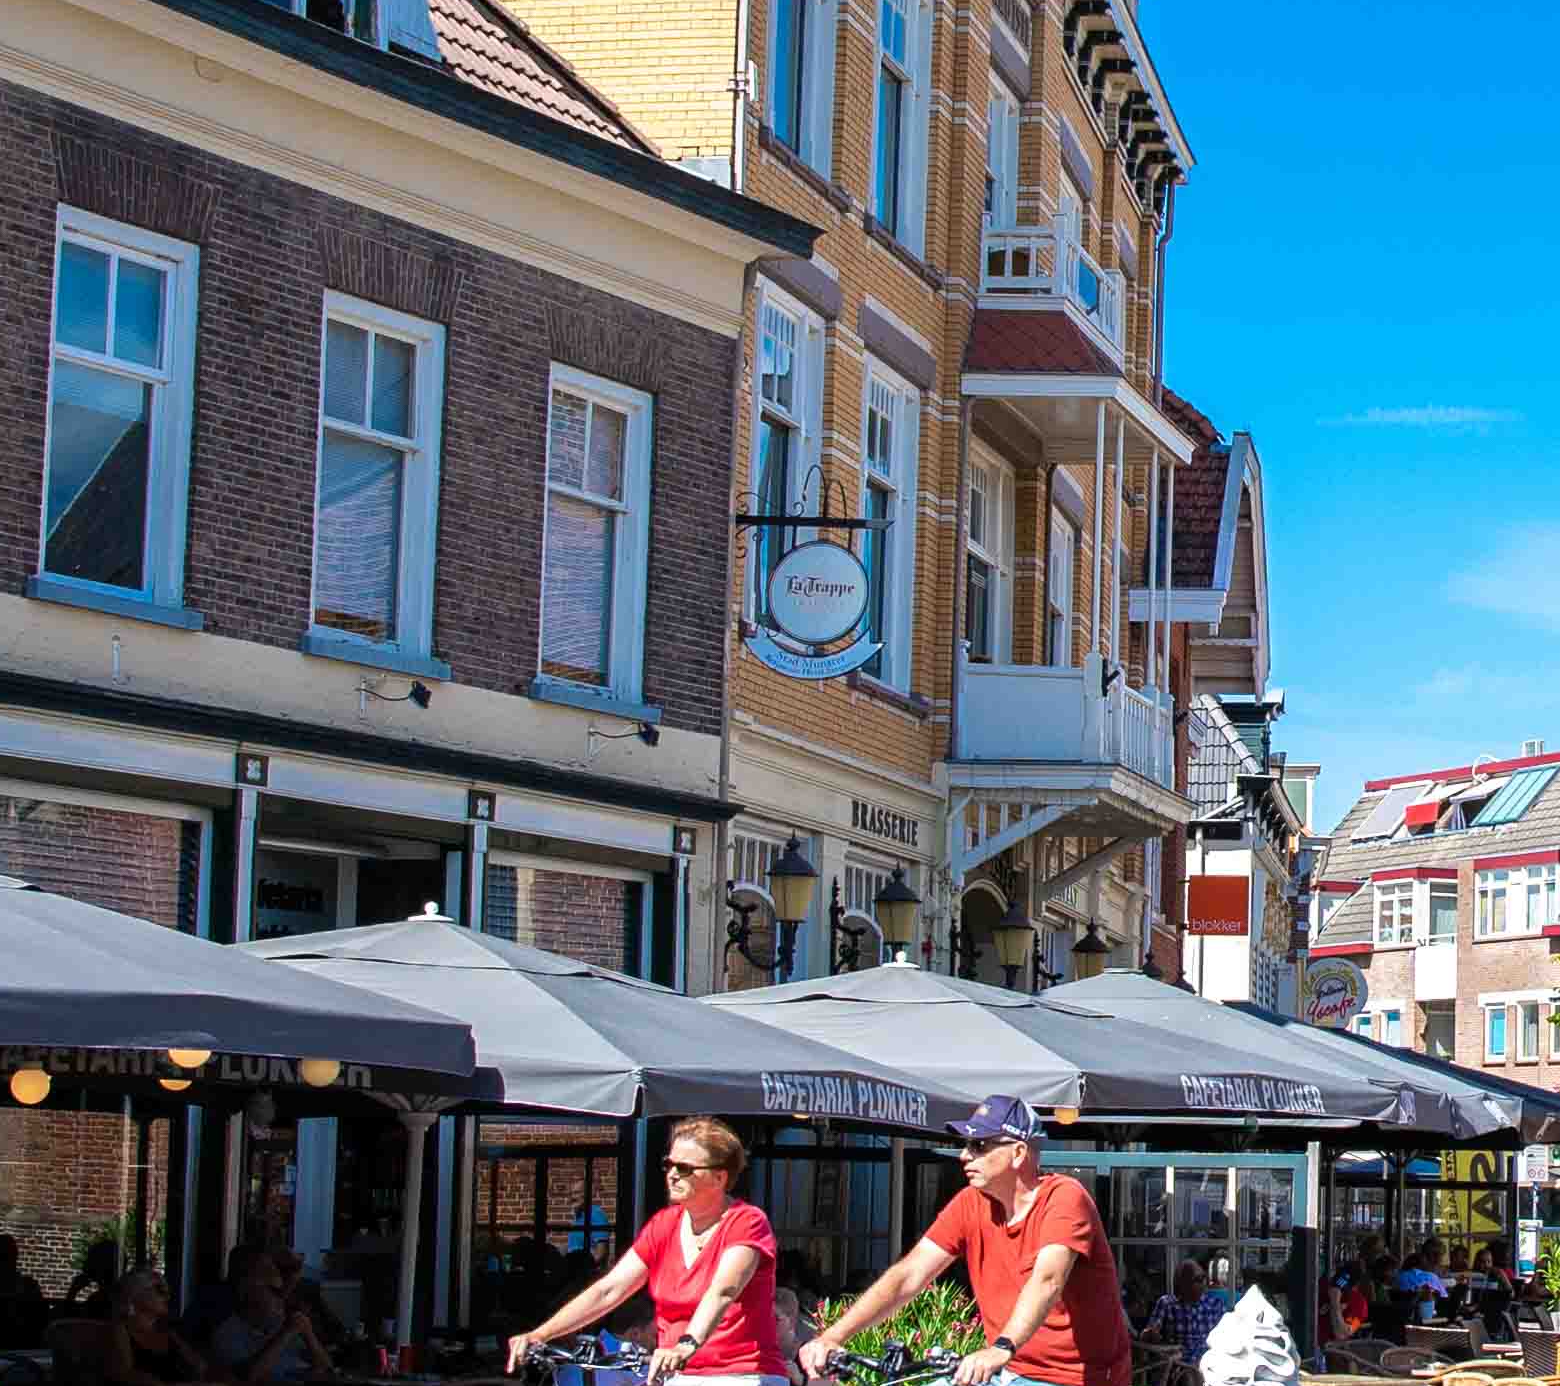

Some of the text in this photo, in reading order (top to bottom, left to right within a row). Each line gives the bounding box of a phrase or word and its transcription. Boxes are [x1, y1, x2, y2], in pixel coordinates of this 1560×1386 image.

[804, 575, 855, 597] Trappe
[852, 800, 918, 846] BRASSERIE
[1192, 917, 1241, 932] blokker
[760, 1072, 928, 1126] CAFETARIA PLOKKER
[1180, 1074, 1326, 1113] CAFETARIA PLOKKER
